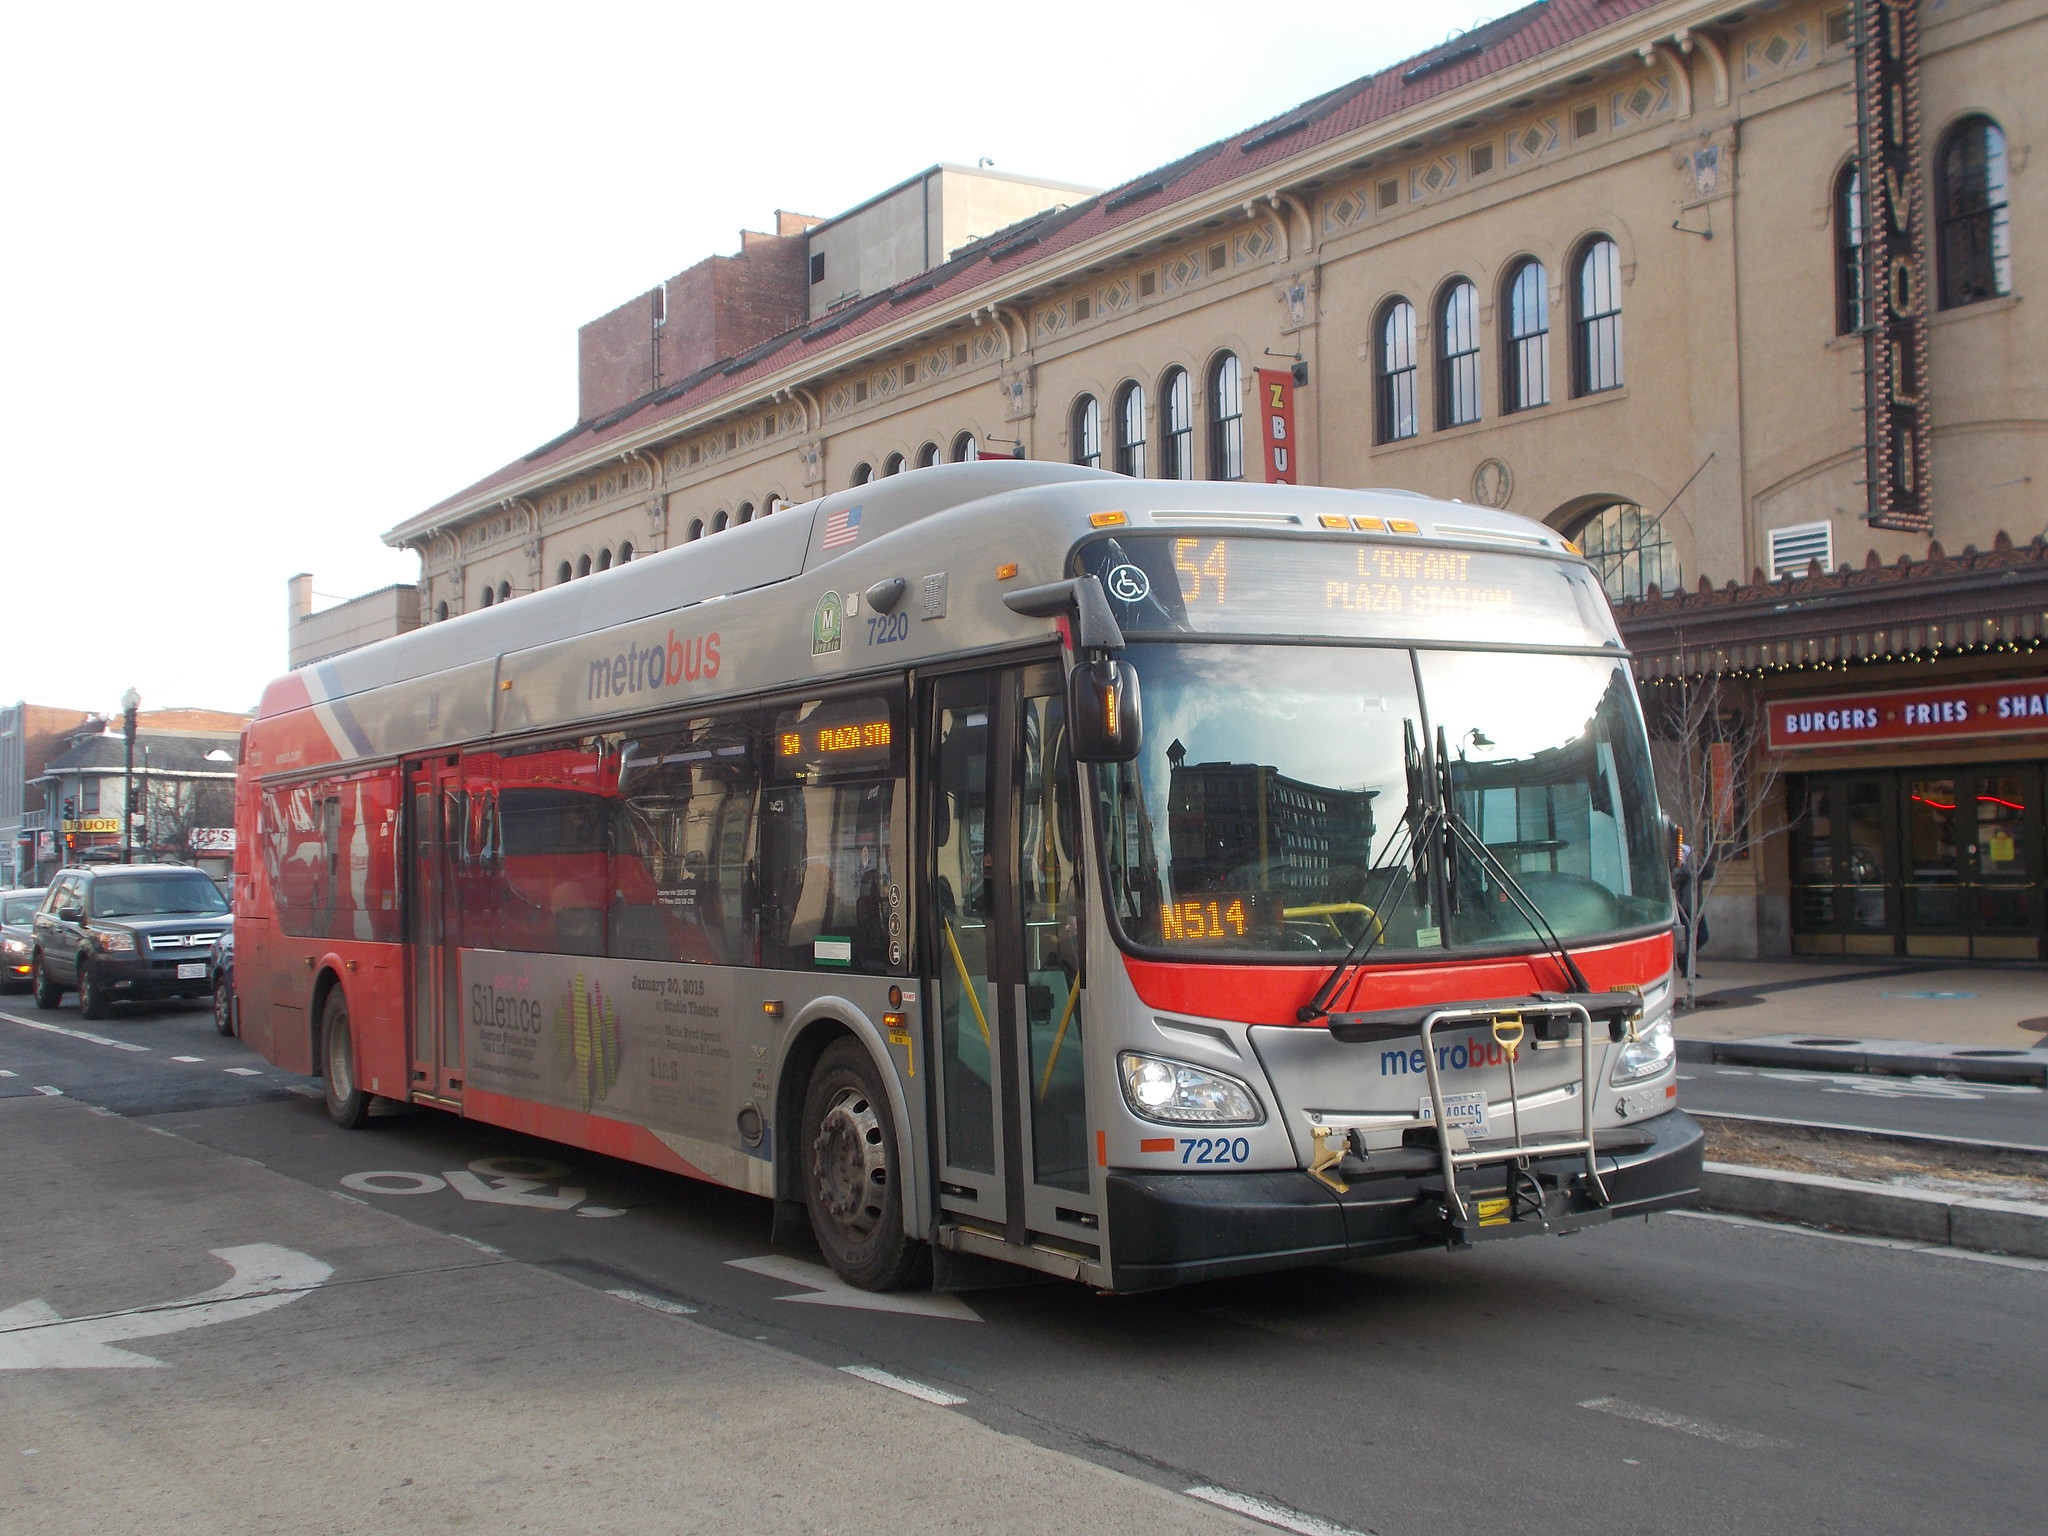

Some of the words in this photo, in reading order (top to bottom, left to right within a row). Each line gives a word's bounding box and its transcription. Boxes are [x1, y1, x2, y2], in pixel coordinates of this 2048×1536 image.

[1269, 383, 1288, 485] ZBU
[1177, 539, 1226, 603] 54
[1358, 548, 1471, 582] L'ENFANT
[1326, 580, 1402, 611] PLAZA
[822, 609, 834, 630] M
[867, 612, 908, 646] 7220
[588, 629, 721, 700] metrobus
[1785, 707, 1878, 733] BURGERS
[1904, 700, 1968, 724] FRIES
[1998, 694, 2048, 719] SHA
[783, 734, 799, 755] 54
[820, 726, 861, 751] PLAZA
[864, 722, 892, 746] STA
[64, 820, 116, 831] LIQUOR
[1161, 899, 1245, 939] N514
[632, 975, 665, 996] January
[903, 992, 915, 1000] RAMP
[472, 983, 542, 1034] Silence
[1381, 1036, 1520, 1077] merobus
[1180, 1138, 1250, 1165] 7220
